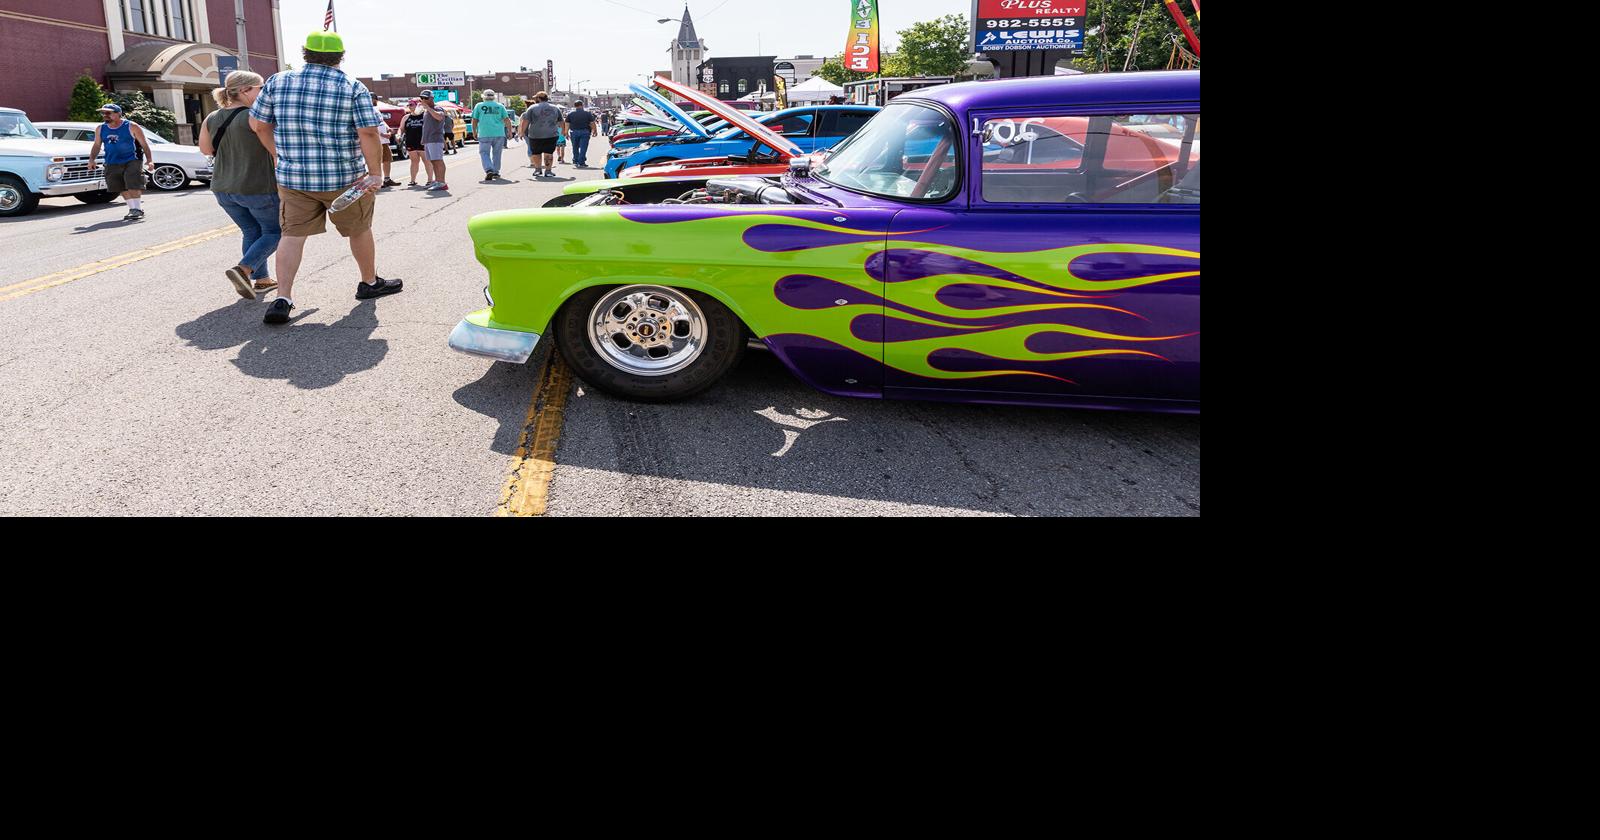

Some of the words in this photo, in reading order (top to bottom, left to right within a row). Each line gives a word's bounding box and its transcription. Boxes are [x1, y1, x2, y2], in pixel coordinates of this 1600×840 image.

[986, 18, 1075, 28] 982-5555
[1000, 30, 1080, 39] LEWIS
[418, 73, 435, 84] CB
